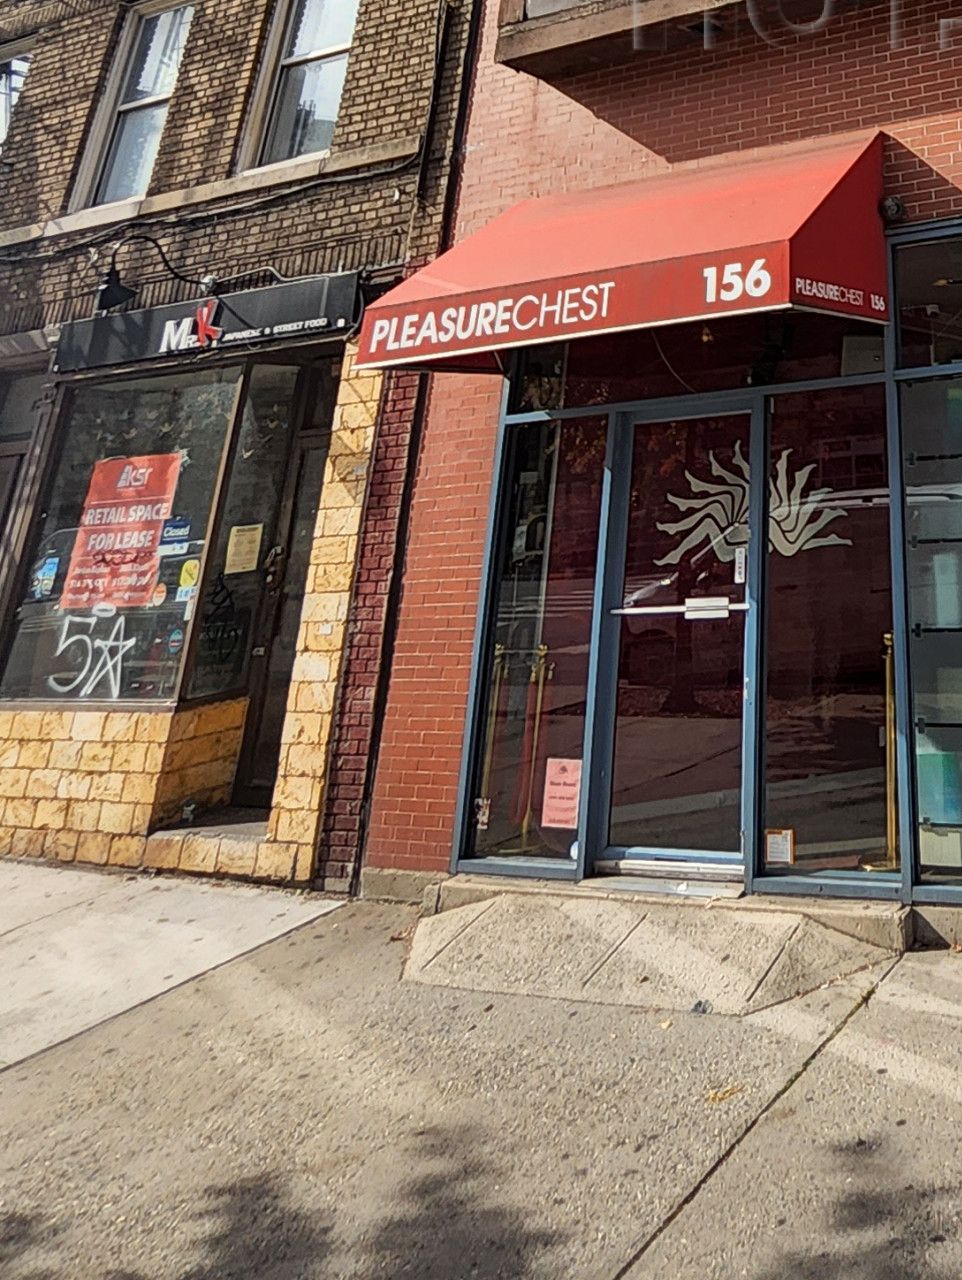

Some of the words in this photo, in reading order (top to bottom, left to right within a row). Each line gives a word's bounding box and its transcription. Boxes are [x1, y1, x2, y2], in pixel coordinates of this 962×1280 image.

[368, 282, 615, 353] PLEASURECHEST
[703, 258, 772, 303] 156
[870, 293, 886, 312] 156
[272, 322, 304, 334] STREET
[304, 317, 328, 330] FOOD
[84, 507, 126, 526] RETAIL
[127, 503, 170, 522] SPACE
[87, 533, 115, 551] FOR
[115, 530, 155, 549] LEASE
[163, 525, 190, 538] Closed
